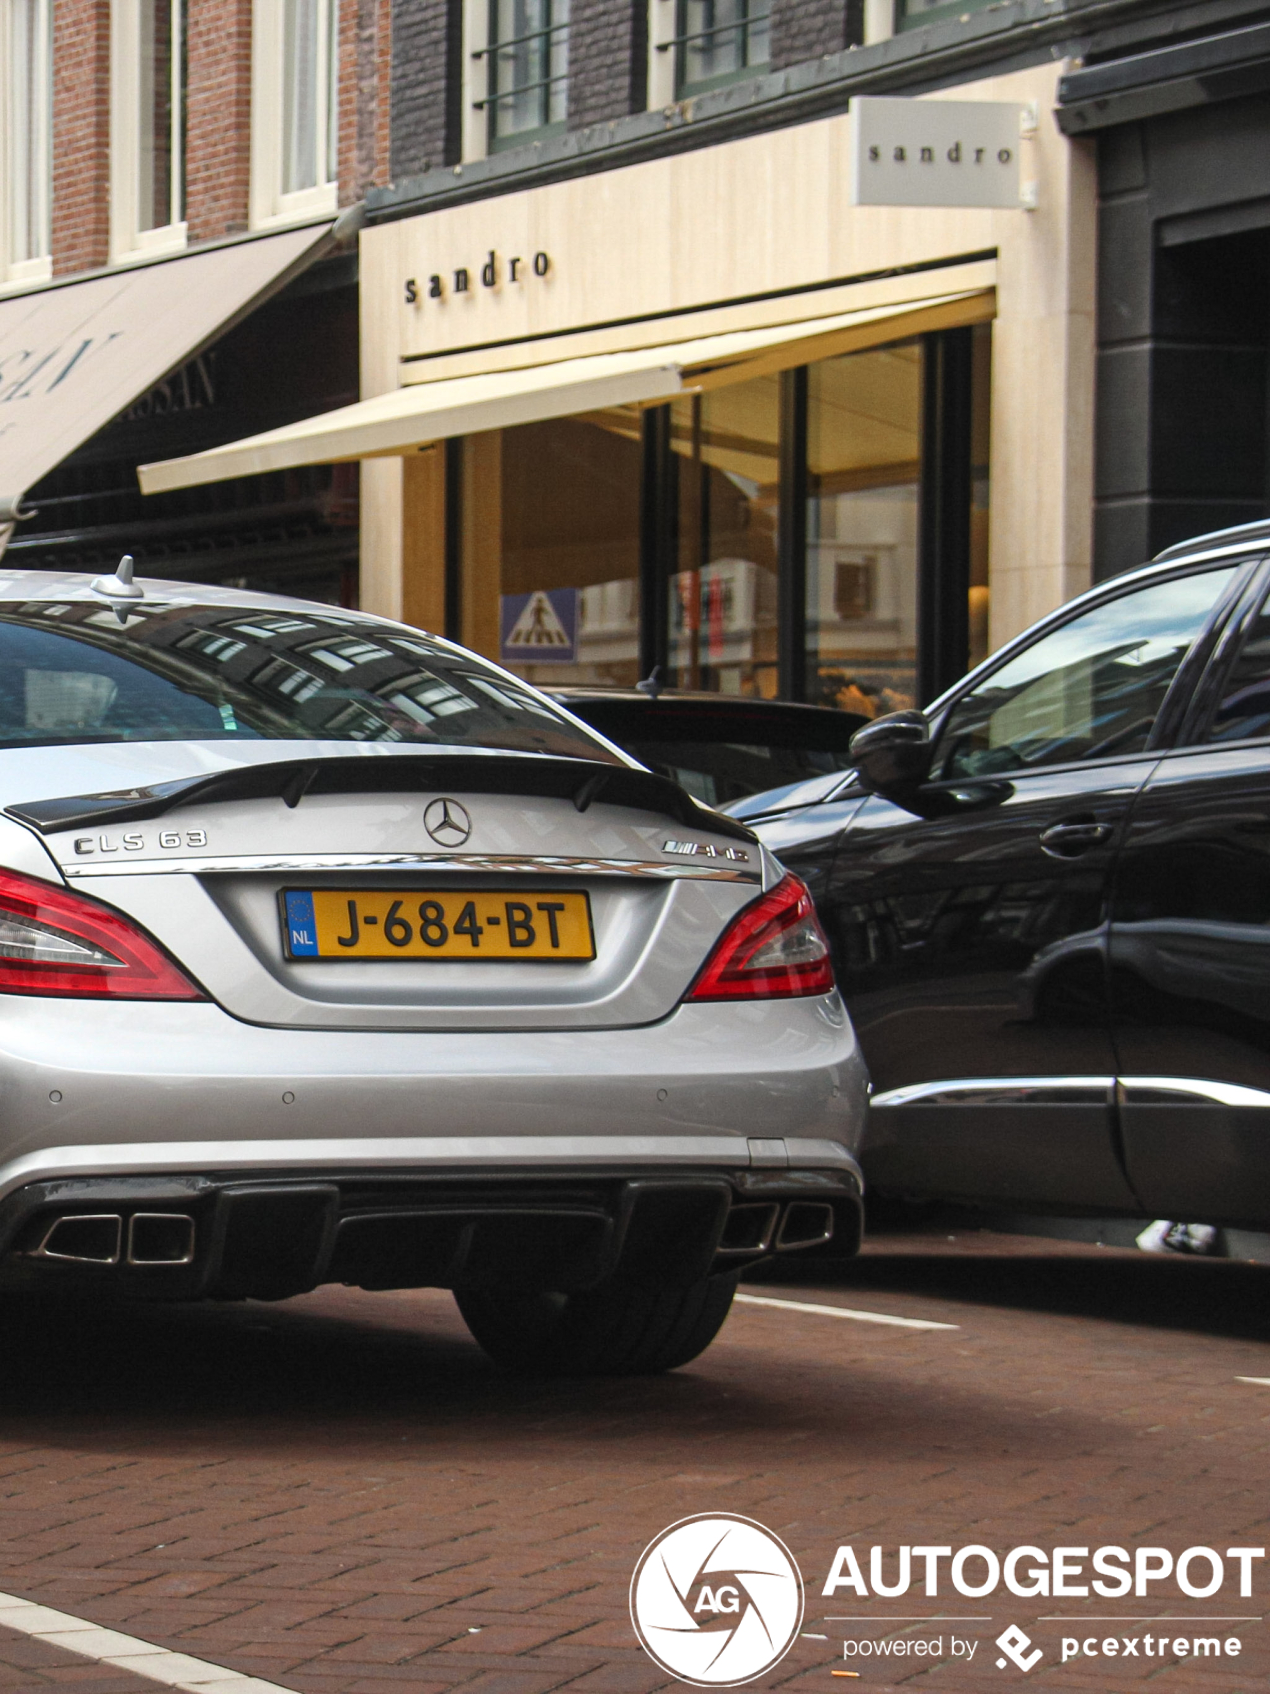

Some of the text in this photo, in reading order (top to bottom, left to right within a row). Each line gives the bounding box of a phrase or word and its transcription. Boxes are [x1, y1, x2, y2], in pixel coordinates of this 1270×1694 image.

[868, 141, 1013, 164] sandro
[405, 250, 549, 304] sandro
[74, 829, 207, 855] CLS 63
[293, 930, 313, 944] NL
[337, 900, 565, 948] J-684-BT
